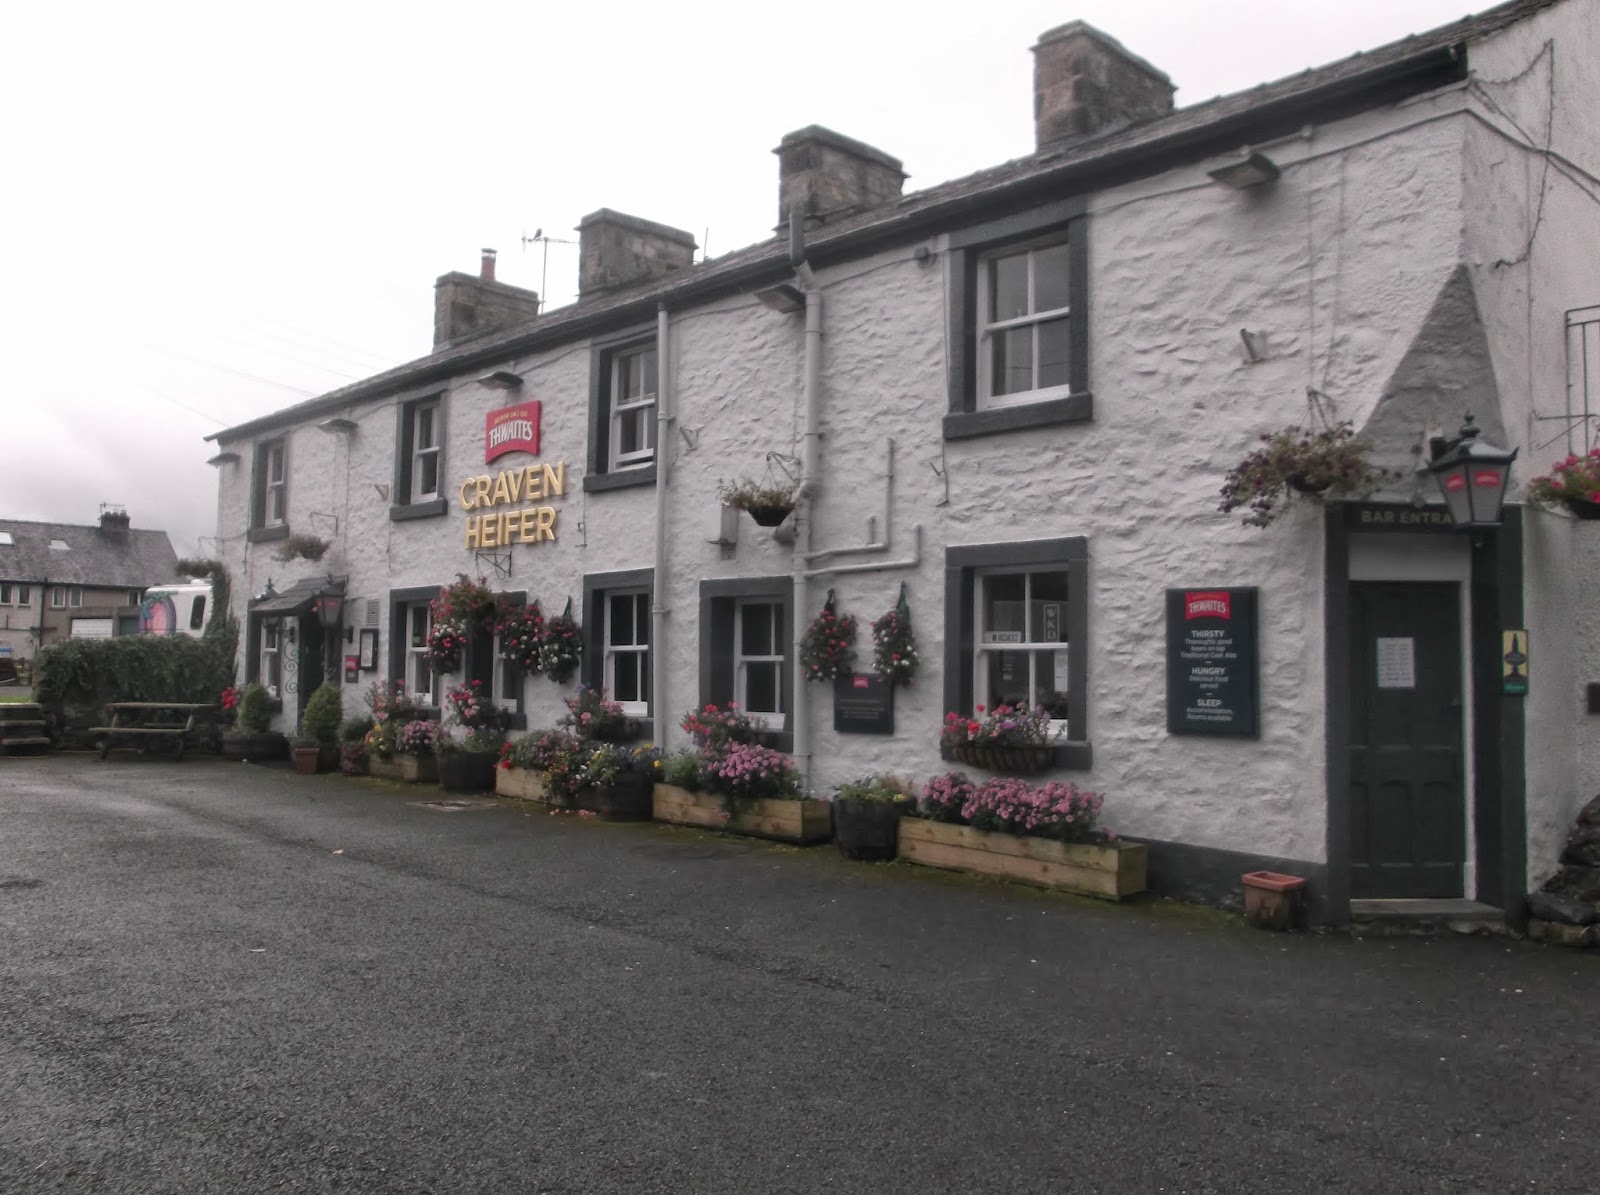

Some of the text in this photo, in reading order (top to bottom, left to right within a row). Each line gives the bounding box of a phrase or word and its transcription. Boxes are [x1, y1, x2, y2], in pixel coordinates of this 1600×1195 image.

[488, 419, 533, 449] THWAITES
[460, 461, 565, 510] CRAVEN
[465, 506, 556, 549] HEIFER
[1361, 510, 1452, 524] BAR ENTRA
[1187, 599, 1226, 613] THWAITES
[1046, 607, 1057, 640] WKD
[1191, 630, 1225, 638] THIRSTY
[1191, 667, 1225, 675] HUNGRY
